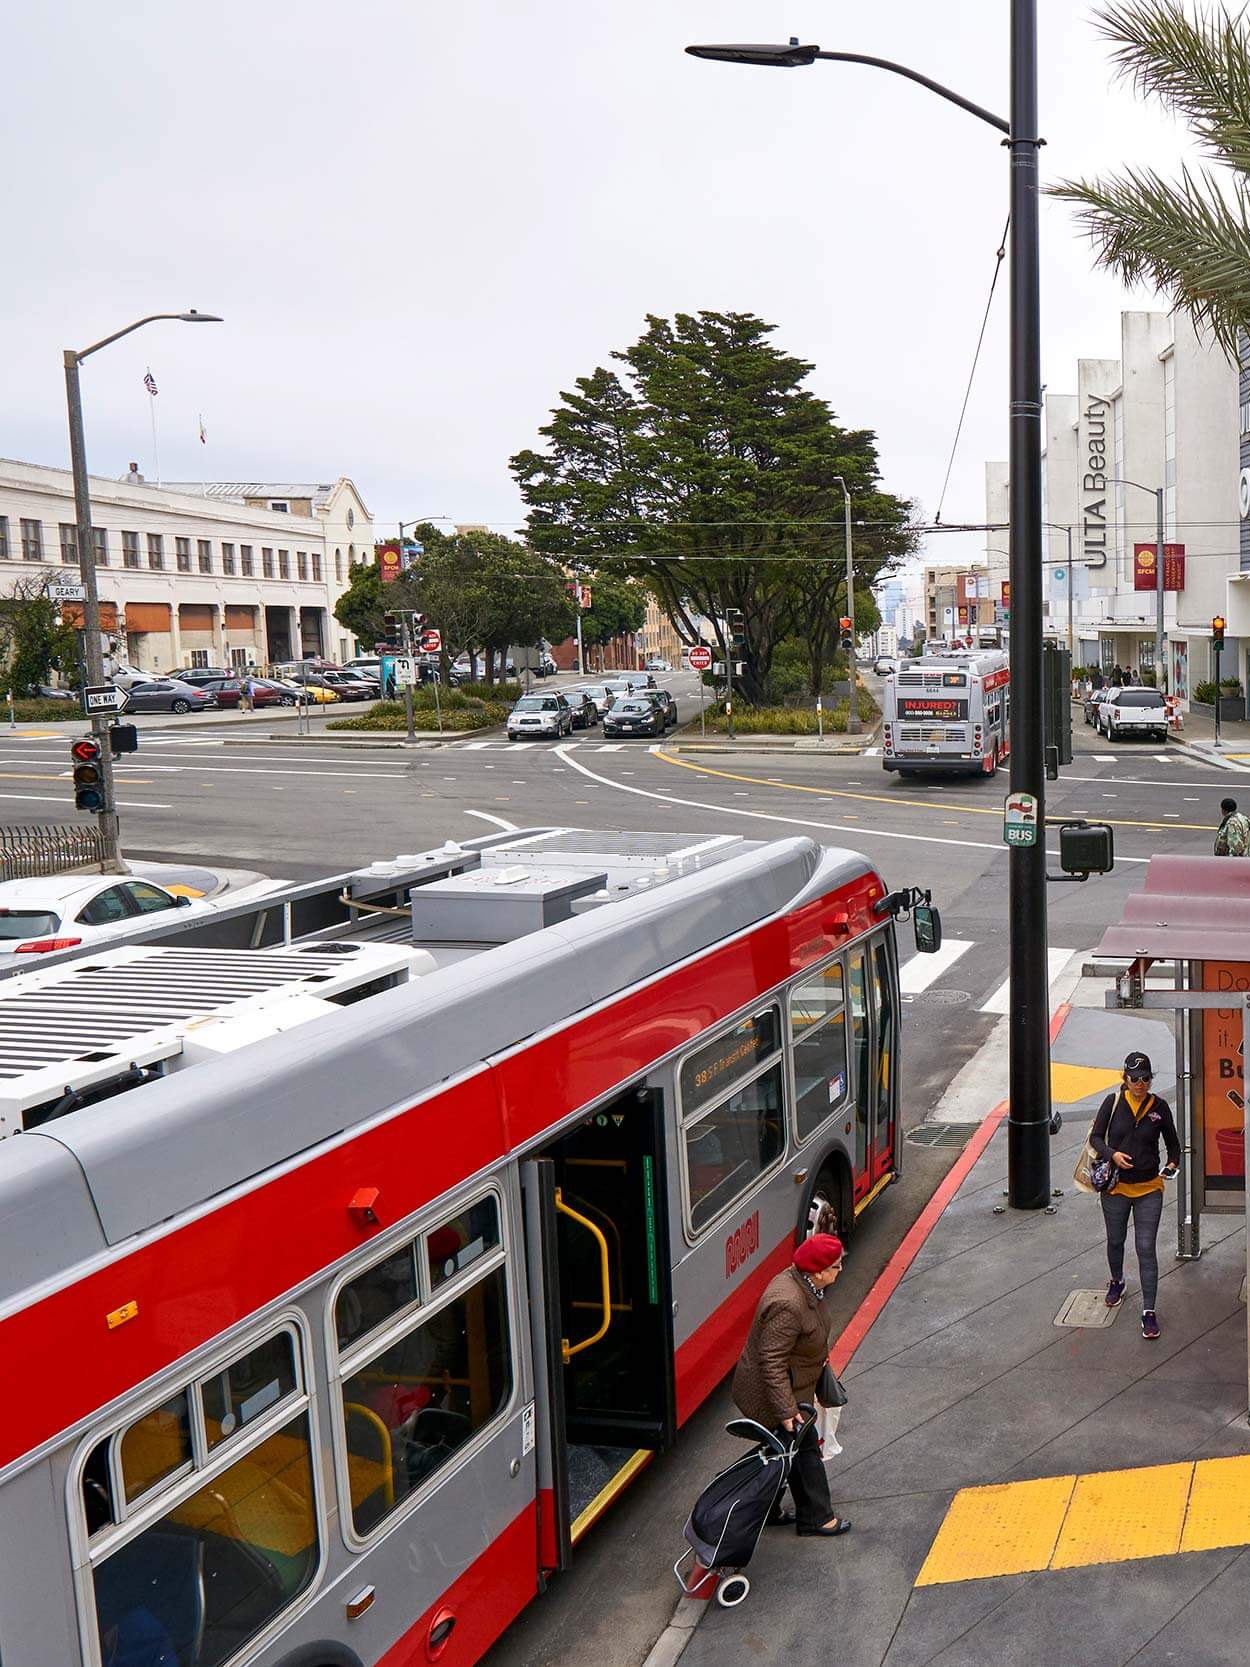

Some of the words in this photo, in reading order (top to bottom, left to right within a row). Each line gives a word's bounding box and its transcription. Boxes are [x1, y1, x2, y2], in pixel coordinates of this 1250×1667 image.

[1083, 393, 1111, 492] Beauty
[1084, 499, 1107, 570] ULTA
[55, 587, 80, 597] GEARY
[89, 695, 102, 706] ONE
[102, 694, 116, 704] WAY
[904, 700, 957, 709] INJURED?
[1008, 829, 1033, 841] BUS
[1218, 1029, 1234, 1048] it.
